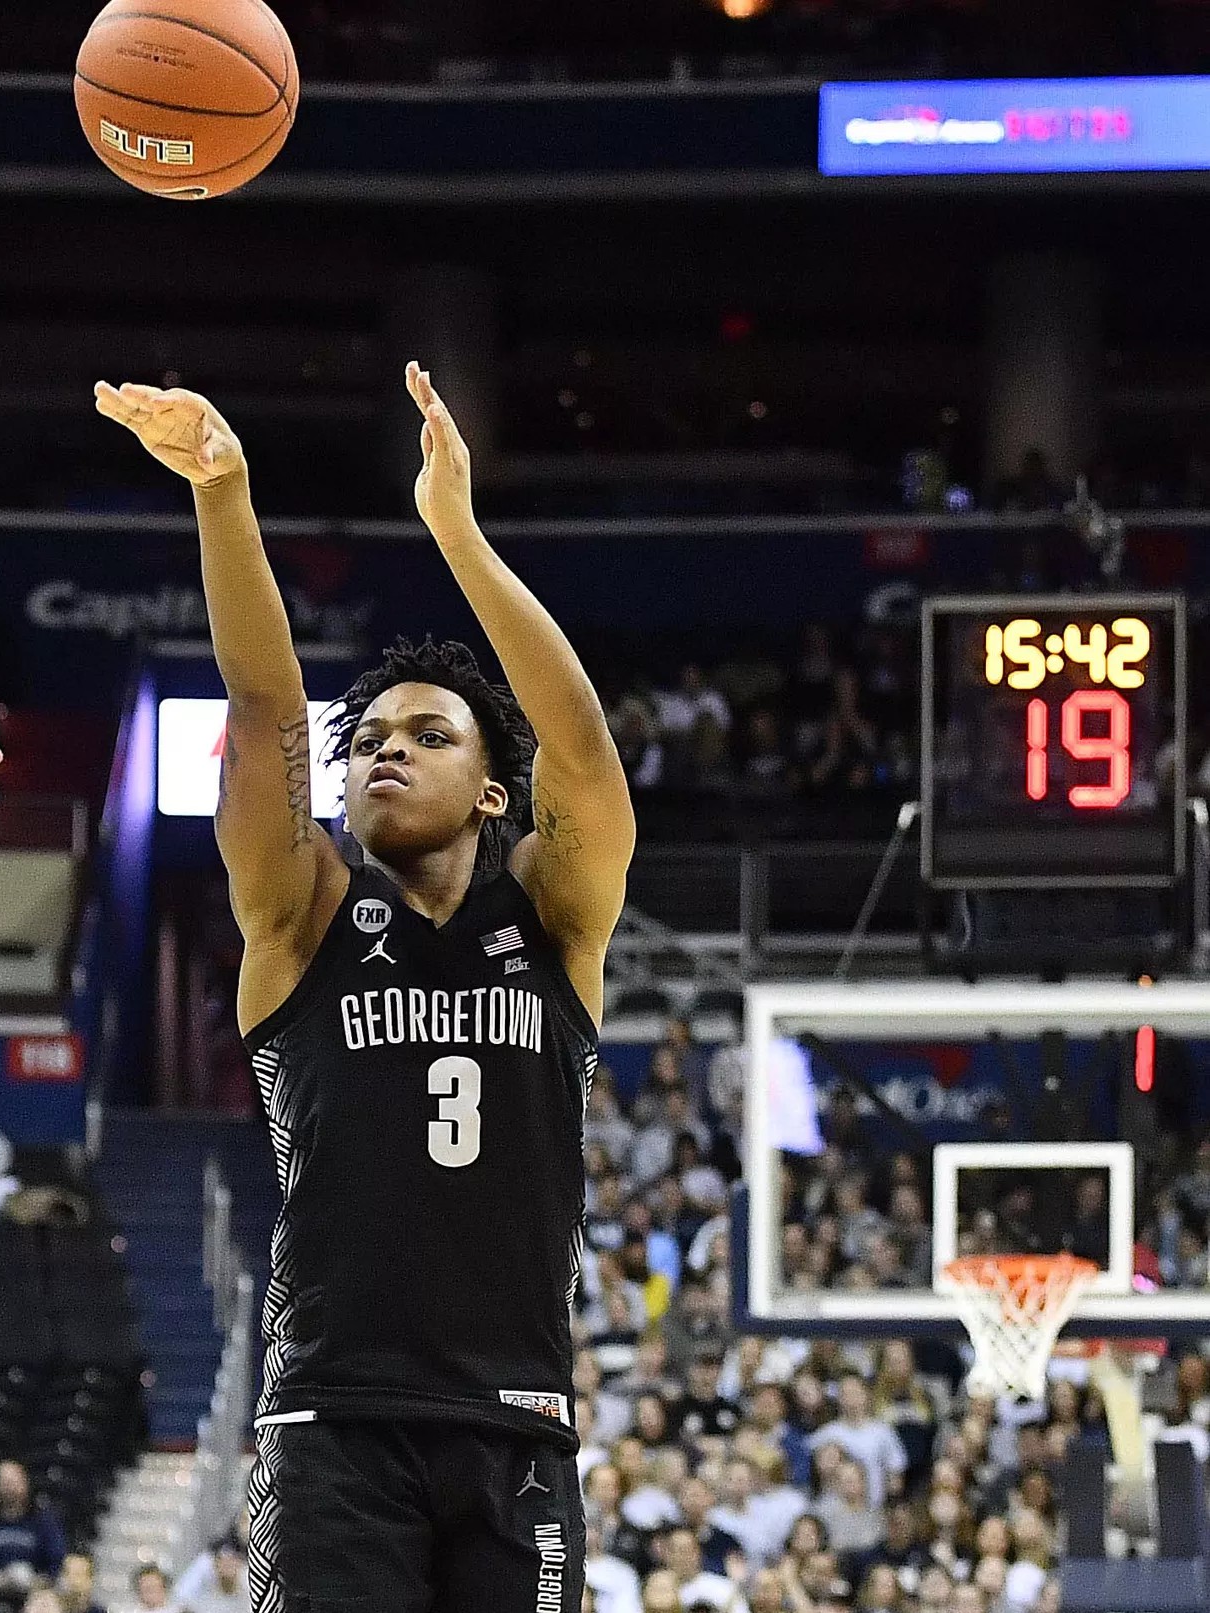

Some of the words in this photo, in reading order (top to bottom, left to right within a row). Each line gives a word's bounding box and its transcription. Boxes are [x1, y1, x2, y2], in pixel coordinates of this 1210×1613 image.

[985, 618, 1150, 690] 15:42
[1027, 690, 1130, 808] 19
[356, 906, 386, 924] FXR
[341, 987, 543, 1054] GEORGETOWN
[427, 1055, 482, 1168] 3
